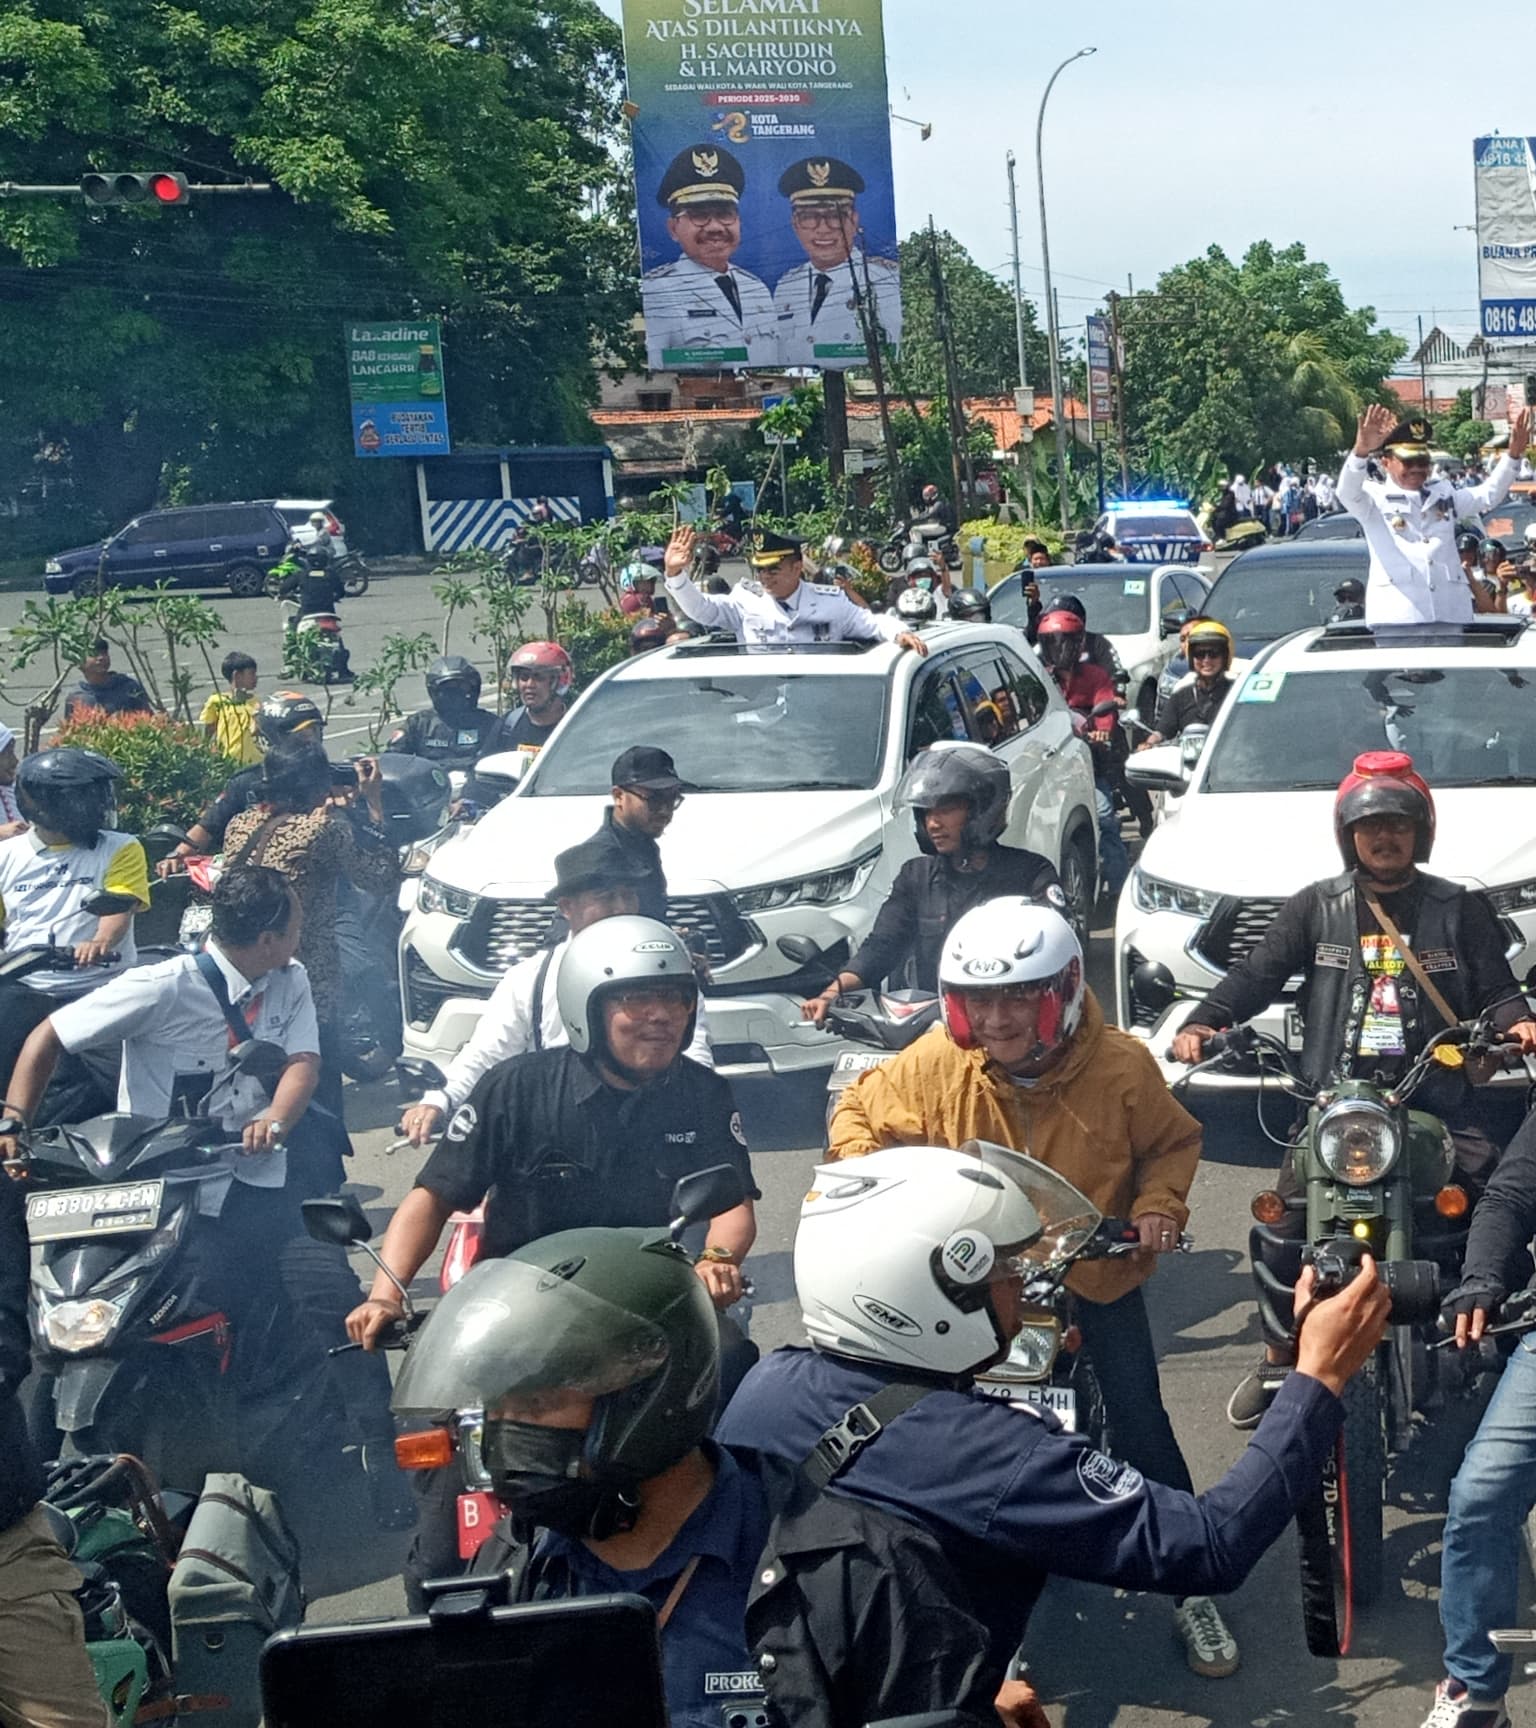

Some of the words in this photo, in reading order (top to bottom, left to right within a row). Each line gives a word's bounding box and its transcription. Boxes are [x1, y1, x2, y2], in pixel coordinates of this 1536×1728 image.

[646, 19, 698, 41] ATAS
[704, 19, 862, 36] DILANTIKNYA
[681, 44, 702, 59] H.
[707, 42, 833, 58] SACHRUDIN
[679, 61, 696, 77] &
[701, 61, 722, 77] H.
[727, 59, 836, 76] MARYONO
[718, 95, 753, 103] PERIODE
[754, 94, 800, 102] 2025-2030
[752, 115, 779, 125] KOTA
[751, 125, 815, 136] TANGERANG
[1485, 306, 1516, 332] 0816
[844, 1057, 852, 1070] B
[864, 1302, 915, 1330] GMT
[1322, 1479, 1338, 1503] 7D
[464, 1500, 479, 1528] B
